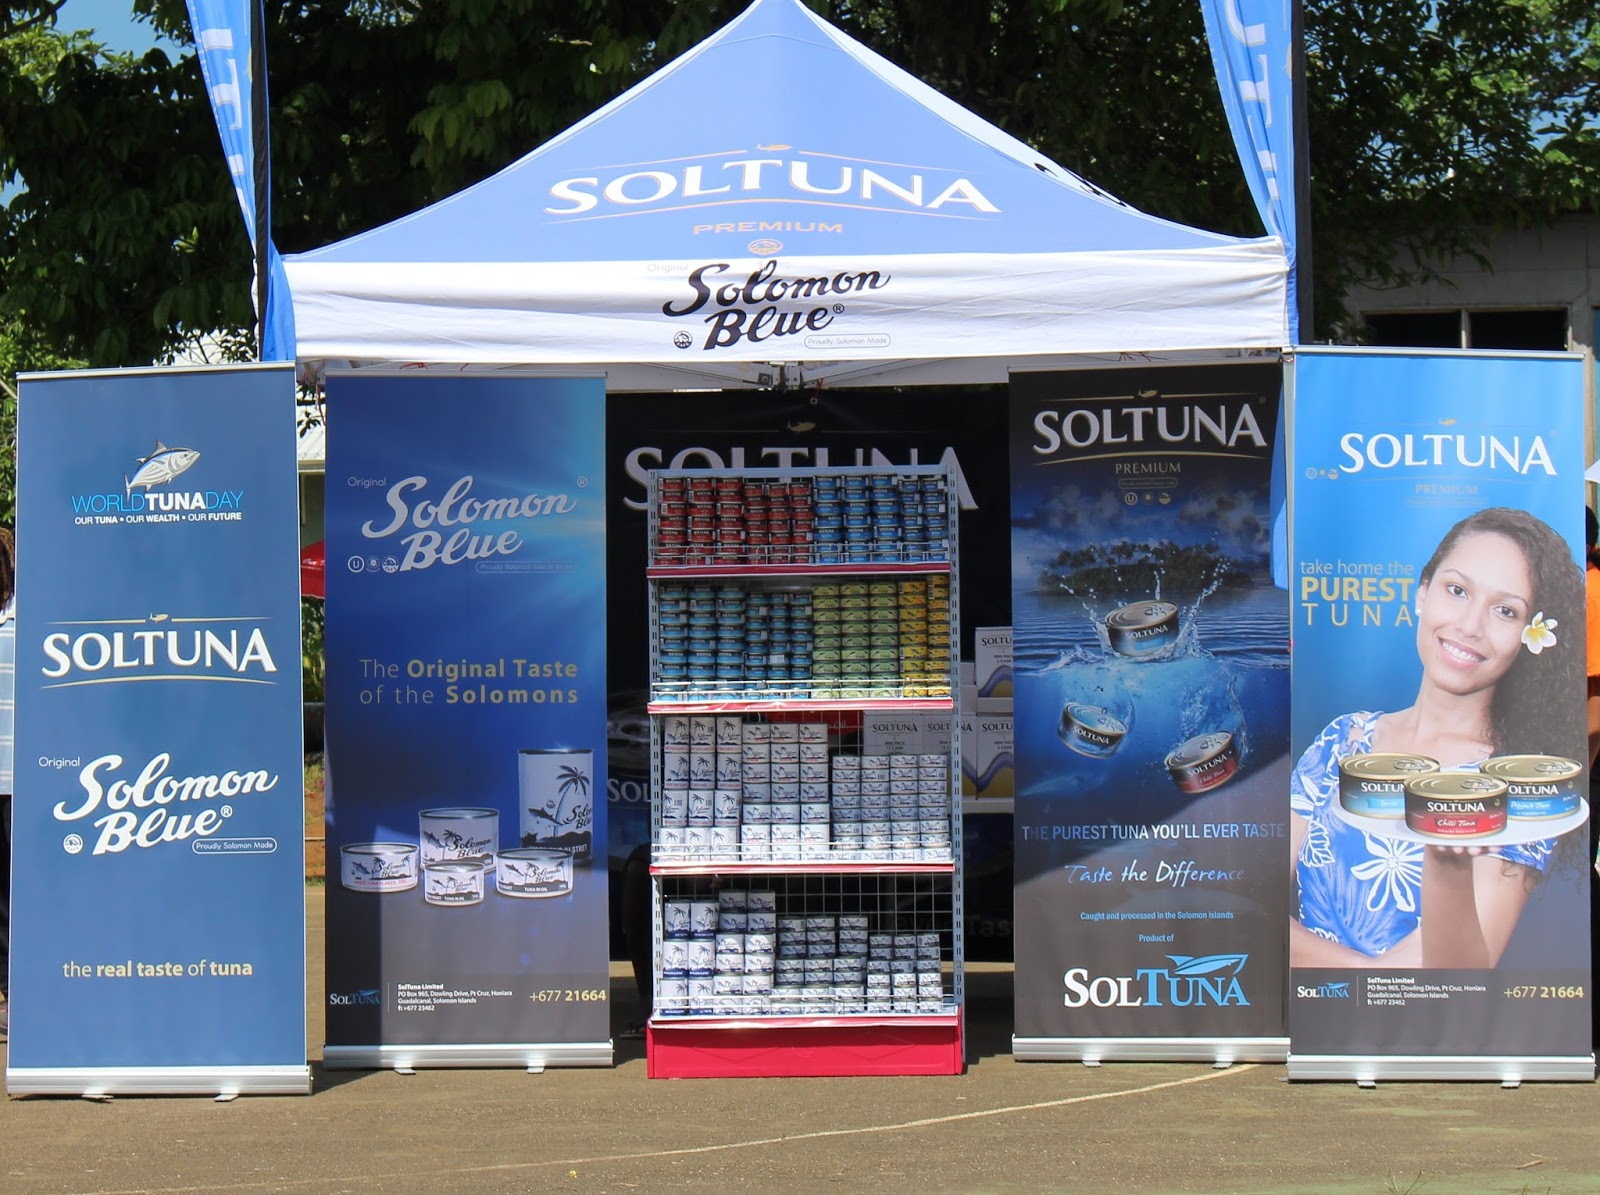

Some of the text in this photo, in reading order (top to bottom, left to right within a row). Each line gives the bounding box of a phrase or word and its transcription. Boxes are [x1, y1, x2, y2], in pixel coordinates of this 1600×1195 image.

[543, 159, 1003, 216] SOLTUNA
[693, 221, 844, 234] PREMIUM
[662, 259, 892, 317] Solomon
[836, 337, 864, 345] Solomon
[1033, 403, 1268, 454] SOLTUNA
[1339, 432, 1557, 474] SOLTUNA
[1115, 462, 1182, 475] PREMIUM
[347, 477, 387, 488] Original
[361, 475, 578, 539] Solomon
[74, 512, 242, 524] OUR TUNA OUR WEALTH OUR FUTURE
[399, 527, 524, 571] Blue
[1301, 560, 1414, 575] take home the
[1301, 576, 1414, 602] PUREST
[1125, 625, 1168, 639] SOLTUNA
[41, 627, 277, 677] SOLTUNA
[360, 659, 578, 682] The Original Taste
[360, 684, 578, 704] of the Solomons
[872, 722, 918, 733] SOLTUNA
[927, 722, 973, 732] SOLTNA
[1073, 726, 1109, 745] SOLTUNA
[38, 757, 81, 769] Original
[1187, 753, 1228, 777] SOLTUNA
[53, 753, 279, 821] Solomon
[1427, 801, 1486, 813] SOLTUNA
[1437, 819, 1476, 828] Chilli Tuna
[1022, 823, 1286, 840] THE PUREST TUNA YOU'LL EVER TASTE
[196, 840, 273, 850] Proudly Solomon Made
[1064, 859, 1245, 888] Taste the Difference
[1080, 912, 1105, 921] Caught
[1106, 911, 1120, 920] and
[1121, 911, 1156, 921] processed
[1157, 911, 1164, 919] in
[1165, 911, 1176, 919] the
[1177, 911, 1207, 919] Solomon
[1138, 934, 1174, 942] Product of
[63, 959, 252, 978] the real taste of tuna
[530, 989, 607, 1002] +677 21664
[1504, 986, 1584, 998] +677 21664
